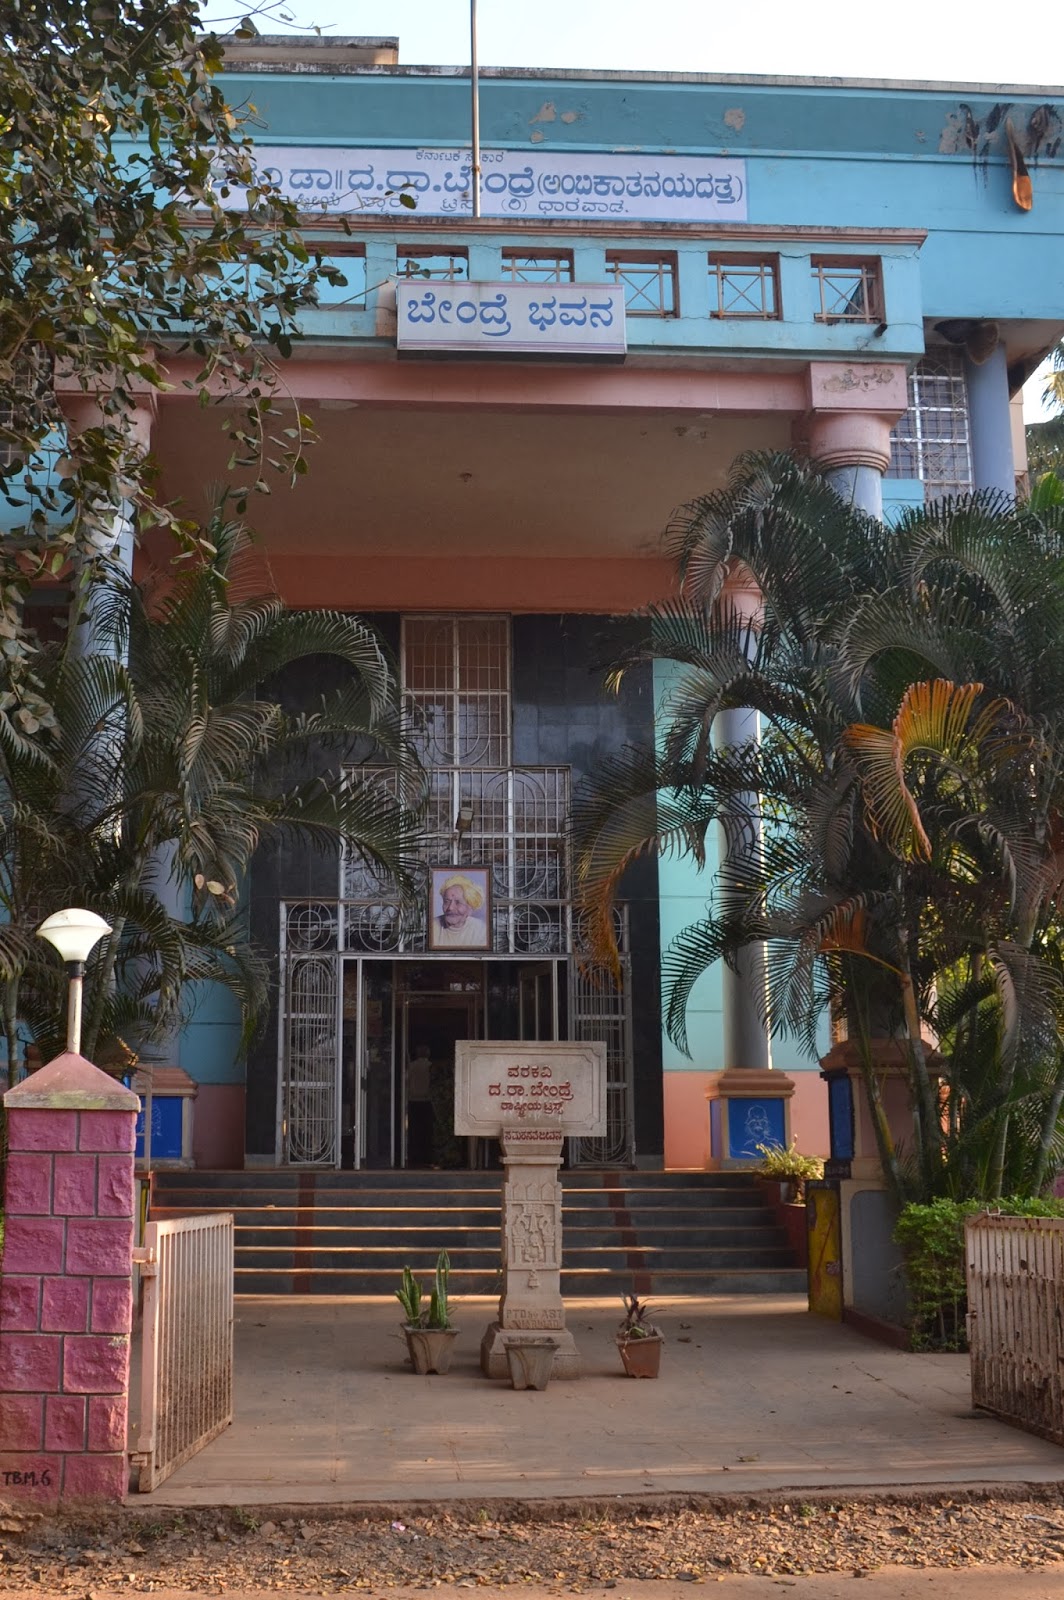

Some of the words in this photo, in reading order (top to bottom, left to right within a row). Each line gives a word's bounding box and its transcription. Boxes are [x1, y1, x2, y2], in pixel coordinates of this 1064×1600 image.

[416, 149, 460, 162] ಕರ್ನಾಟಕ
[465, 151, 504, 163] ಸಕಾರ
[407, 292, 512, 337] ಬೇಂದ್ರೆ
[528, 296, 614, 332] ಭವನ
[507, 1065, 553, 1078] ವರಕವಿ
